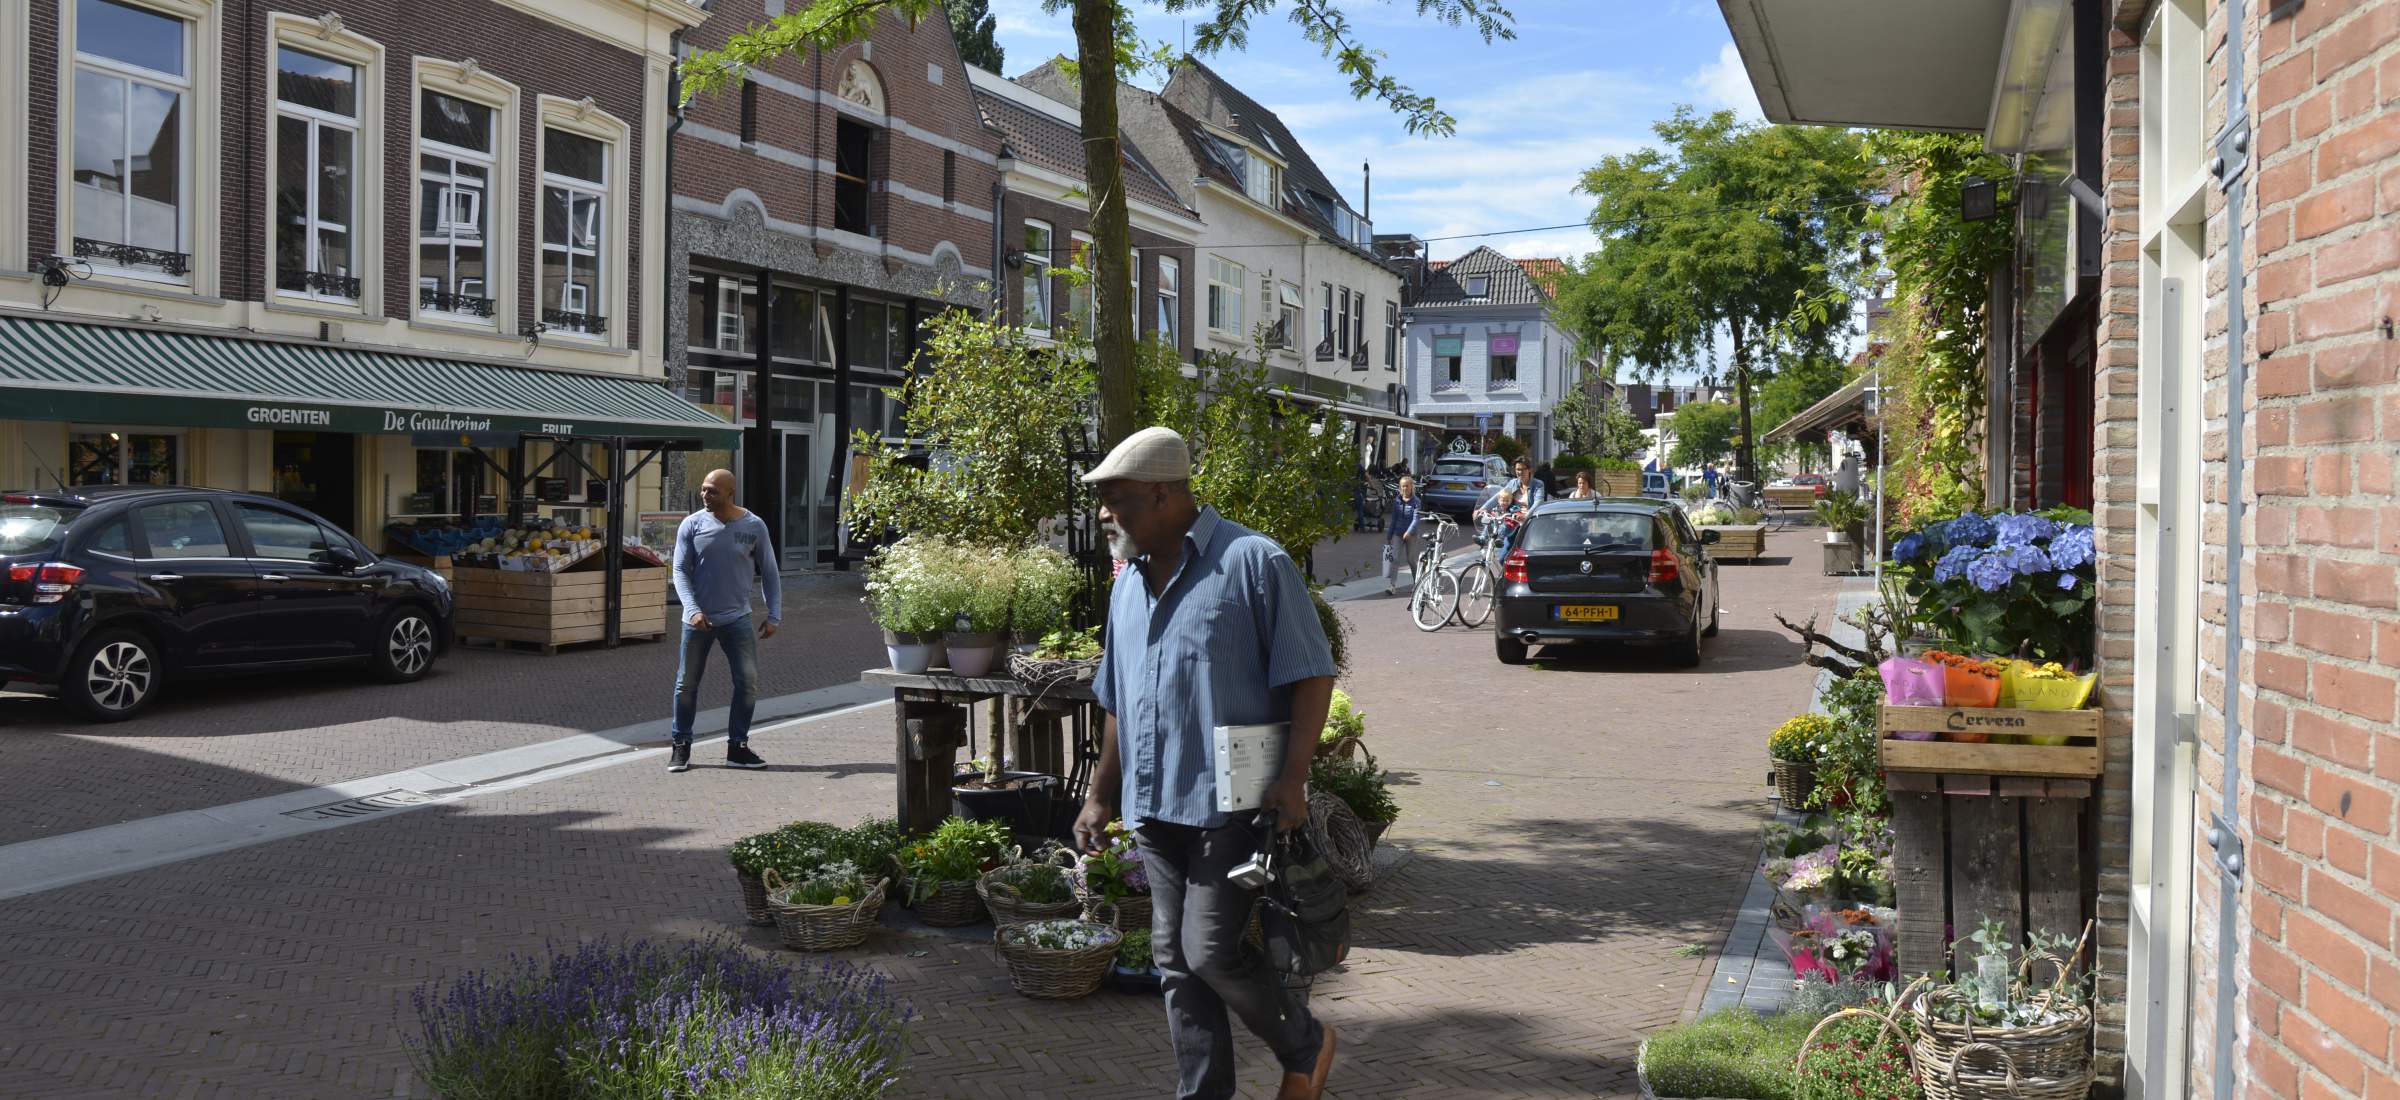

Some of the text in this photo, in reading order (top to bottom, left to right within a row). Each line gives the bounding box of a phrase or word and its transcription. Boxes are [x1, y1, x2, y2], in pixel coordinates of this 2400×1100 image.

[247, 407, 330, 425] GROENTEN
[384, 410, 492, 431] De Goudreinet
[542, 423, 574, 435] FRUIT
[1565, 607, 1613, 617] 64-PFH-1
[1947, 711, 2025, 731] Cerveza
